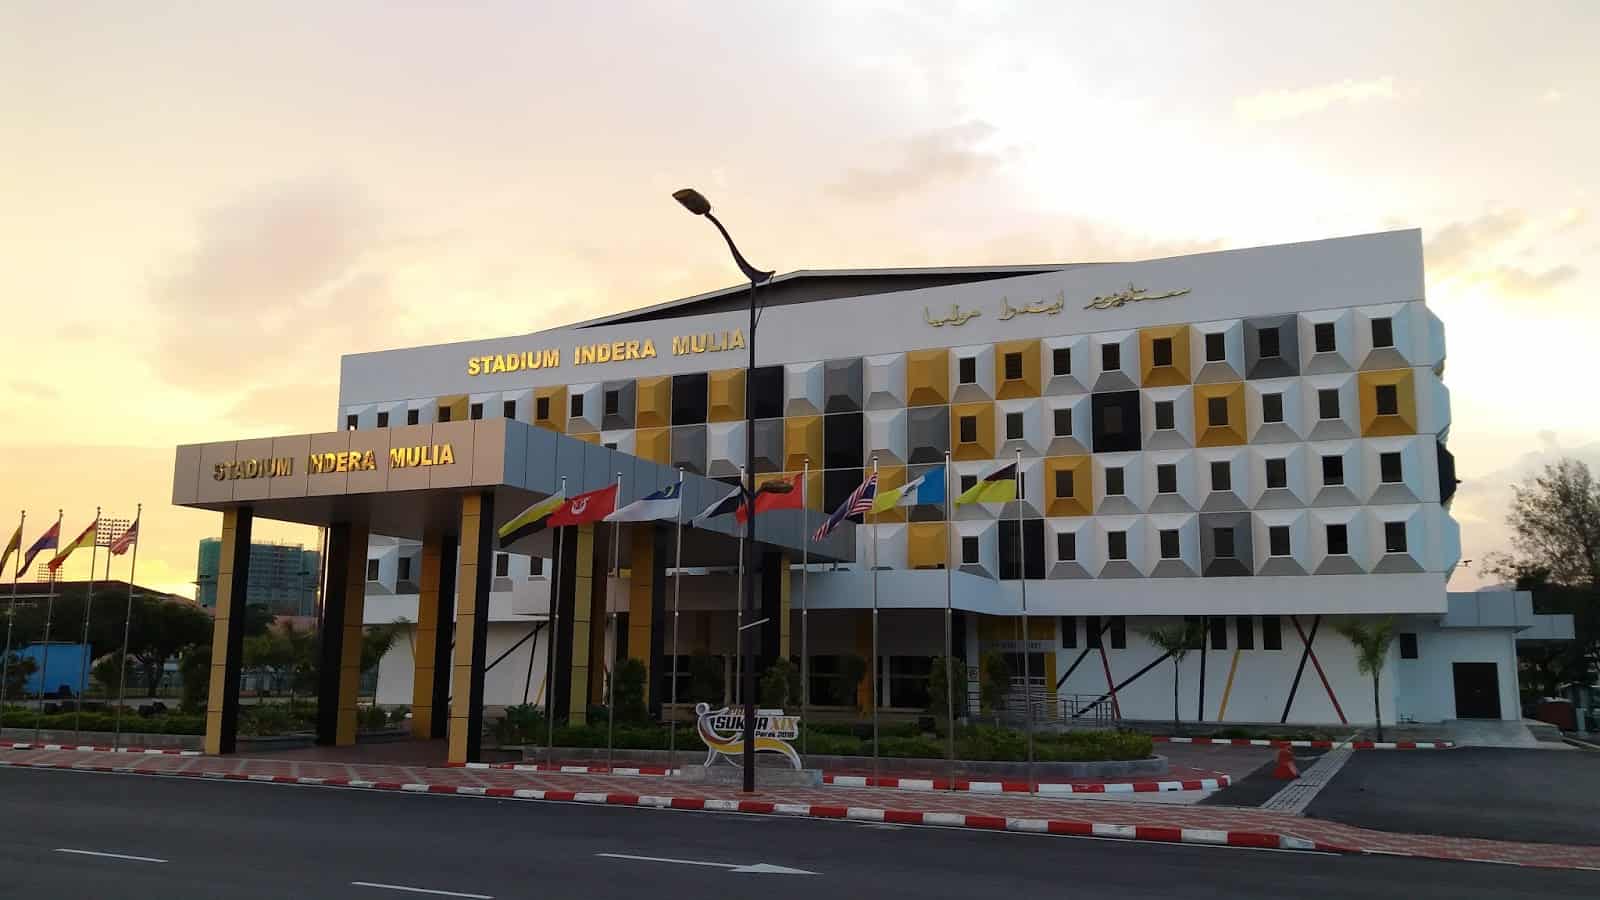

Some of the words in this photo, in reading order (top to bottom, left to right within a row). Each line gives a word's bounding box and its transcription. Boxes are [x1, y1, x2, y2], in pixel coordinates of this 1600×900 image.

[467, 348, 561, 377] STADIUM
[574, 339, 657, 366] INDERA
[672, 328, 745, 356] MULIA
[213, 456, 295, 481] STADIUM
[389, 444, 456, 469] MULIA
